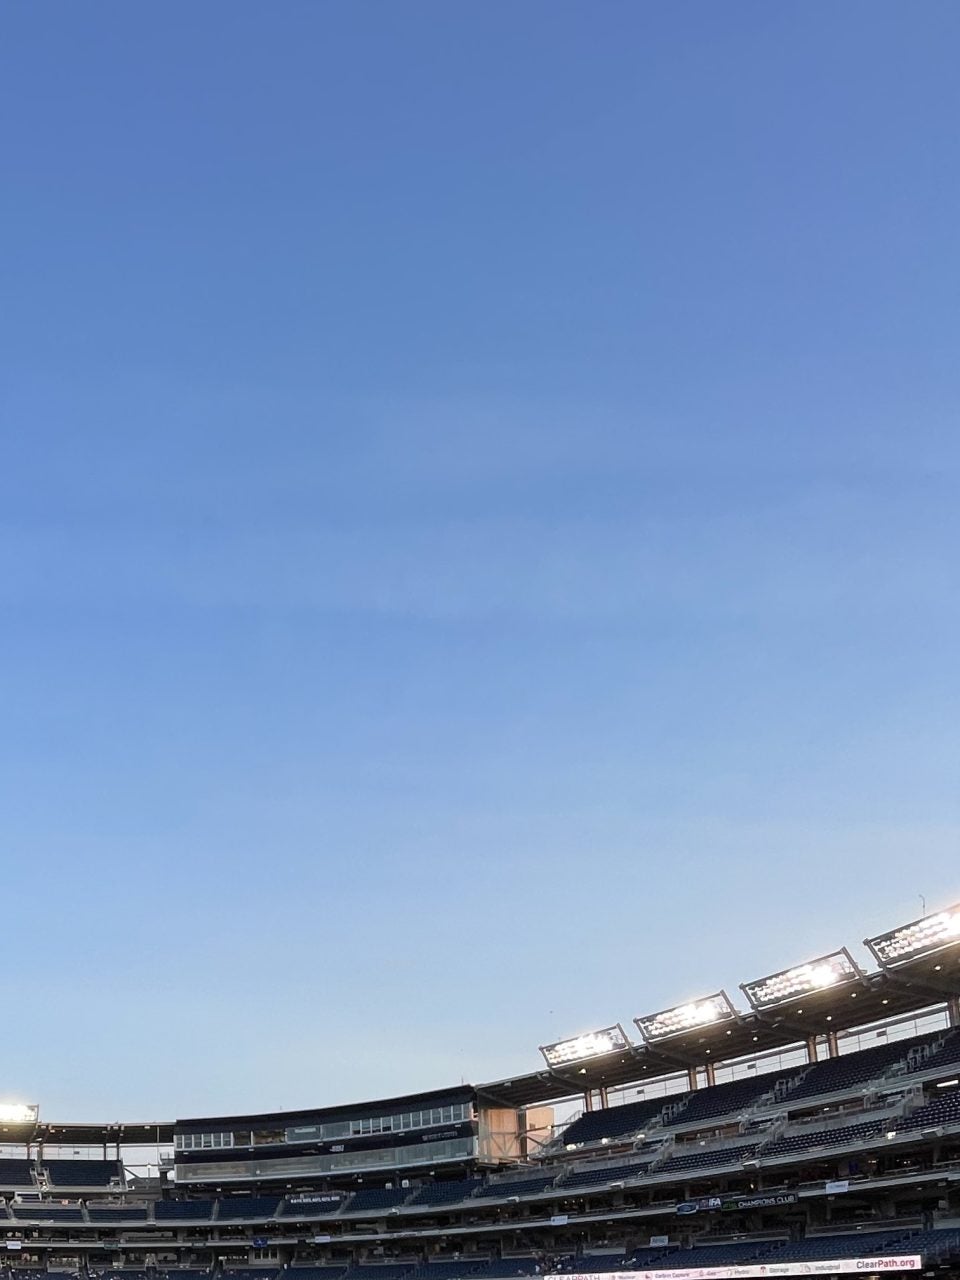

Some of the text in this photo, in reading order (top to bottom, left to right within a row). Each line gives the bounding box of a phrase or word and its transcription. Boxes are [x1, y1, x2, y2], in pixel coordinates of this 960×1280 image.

[738, 1197, 775, 1208] CHAMPIONS
[776, 1195, 795, 1203] CLUB
[856, 1259, 915, 1269] ClearPath.org
